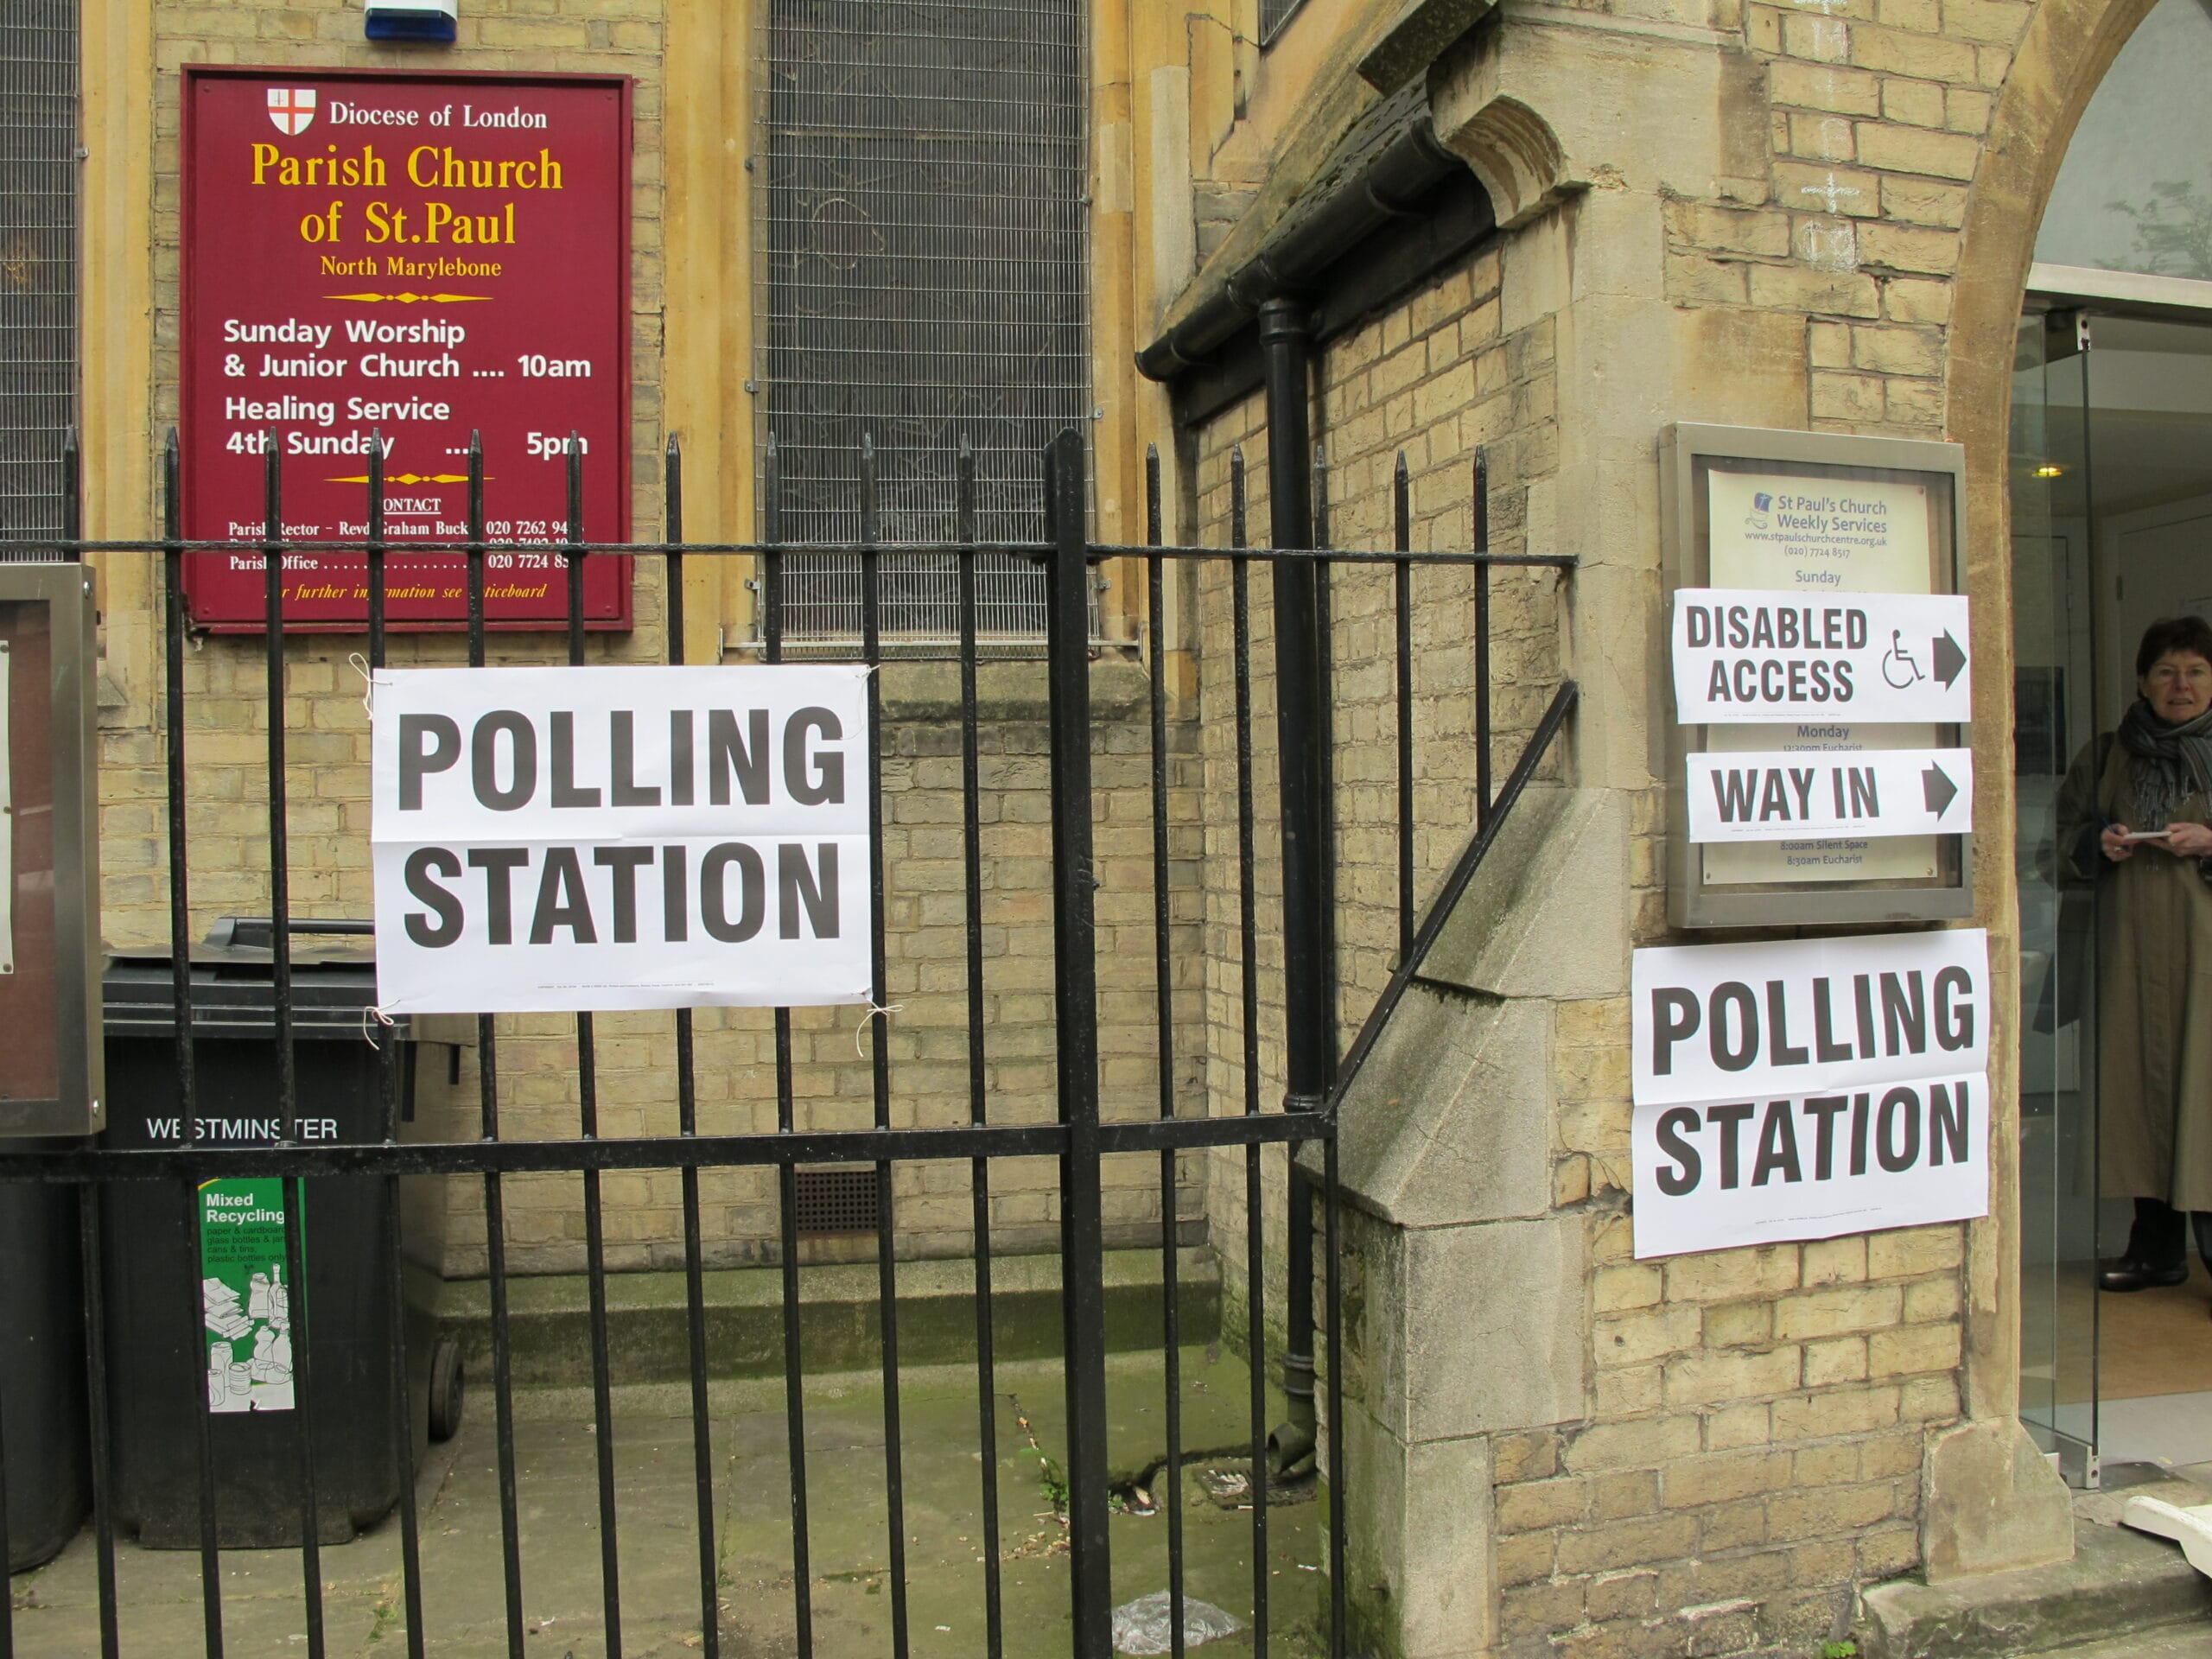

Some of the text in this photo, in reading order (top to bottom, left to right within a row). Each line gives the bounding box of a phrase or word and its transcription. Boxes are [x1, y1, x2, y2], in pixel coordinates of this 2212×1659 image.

[330, 102, 547, 128] Diocese of London
[251, 144, 563, 188] Parish Church
[301, 201, 515, 243] of St.Paul
[321, 257, 501, 279] North Marylebone
[225, 318, 465, 349] Sunday Worship
[225, 354, 245, 377] &
[260, 353, 347, 377] Junior
[360, 353, 459, 377] Church
[518, 355, 590, 377] 10am
[226, 396, 449, 426] Healing Service
[226, 430, 269, 454] 4th
[288, 429, 394, 460] Sunday
[528, 430, 588, 461] 5pm
[384, 499, 442, 512] ONTACT
[1778, 495, 1886, 515] St Paul's Church
[340, 522, 369, 535] Revd
[486, 521, 511, 534] 020
[517, 521, 546, 534] 7262
[1777, 514, 1886, 534] Weekly Services
[1745, 531, 1887, 548] www.stpaulschurchcentre.org.uk
[488, 555, 512, 568] 020
[518, 555, 548, 568] 7724
[1784, 545, 1850, 558] (020) 7724 8517
[1796, 570, 1841, 587] Sunday
[295, 584, 347, 601] further
[442, 588, 461, 597] see
[484, 584, 547, 597] ticeboard
[1688, 607, 1866, 649] DISABLED
[1708, 660, 1853, 702] ACCESS
[1797, 725, 1849, 741] Monday
[400, 707, 844, 810] POLLING
[1711, 767, 1878, 822] WAY IN
[1780, 839, 1869, 851] 8:00am Silent Space
[1787, 854, 1863, 867] 8:30am Eucharist
[404, 842, 839, 948] STATION
[1652, 966, 1974, 1075] POLLING
[1656, 1082, 1968, 1196] STATION
[207, 1193, 252, 1206] Mixed
[207, 1209, 284, 1224] Recycling
[207, 1255, 235, 1264] plastic
